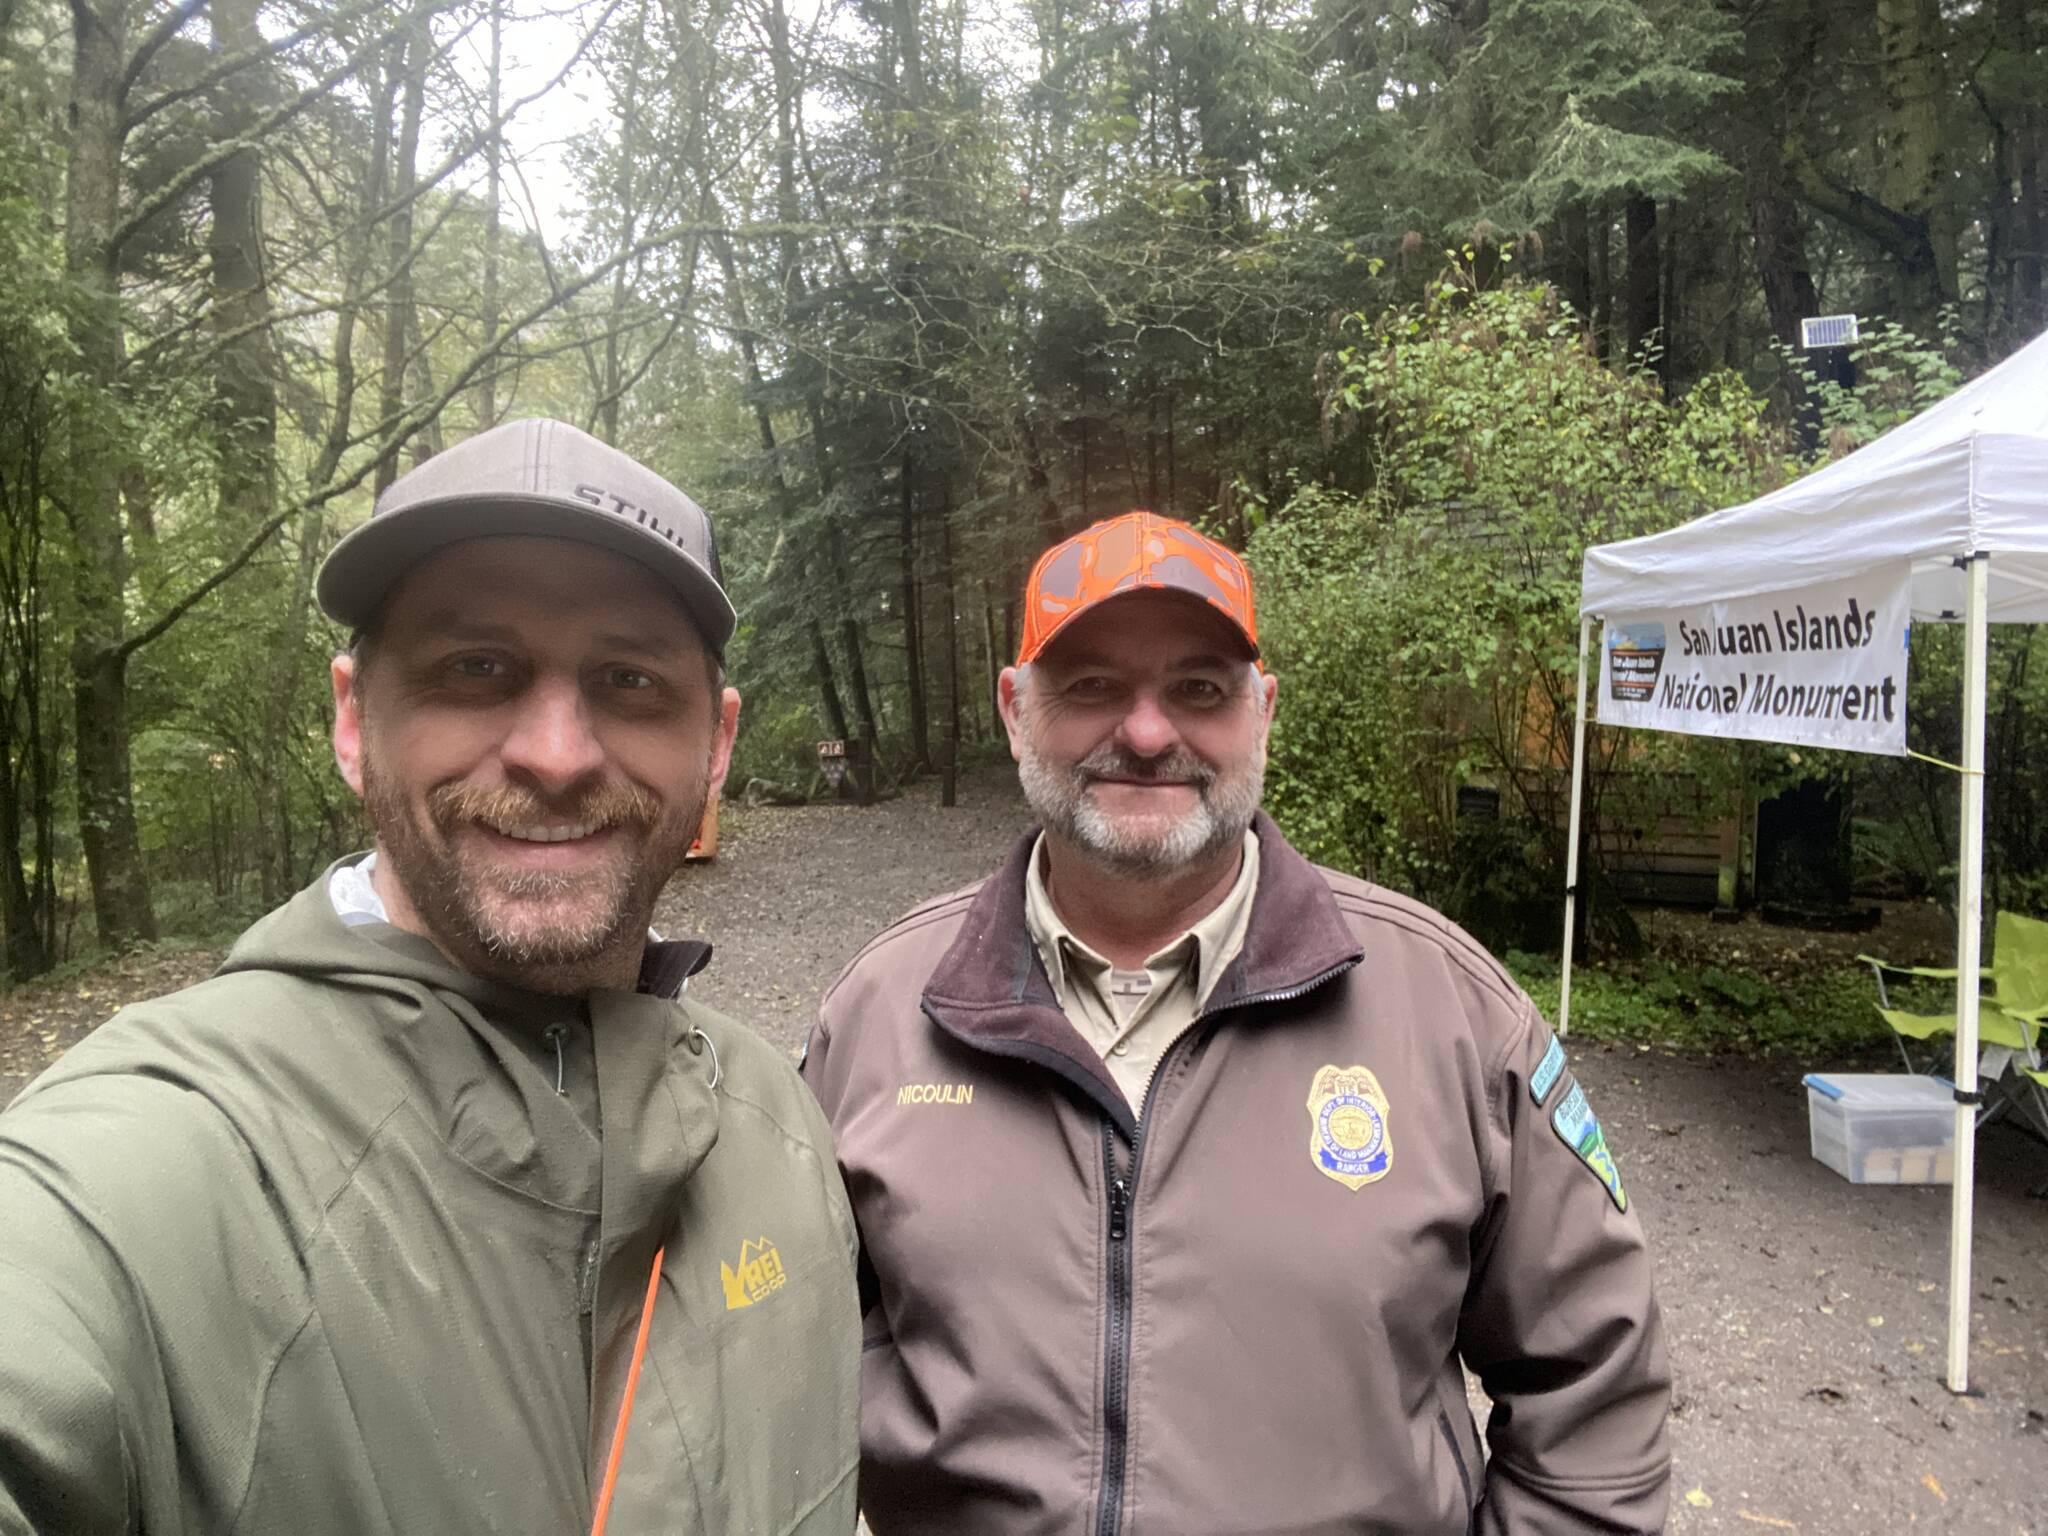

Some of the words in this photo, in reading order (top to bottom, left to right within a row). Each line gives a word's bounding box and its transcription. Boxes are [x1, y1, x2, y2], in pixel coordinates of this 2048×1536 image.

[1679, 619, 1713, 657] San
[1773, 597, 1877, 652] Islands
[1659, 672, 1748, 715] National
[1748, 672, 1898, 724] Monument
[896, 1083, 974, 1105] NICOULIN
[1336, 1161, 1370, 1174] RANGER
[1338, 1148, 1357, 1160] LAND
[746, 1248, 783, 1292] REI
